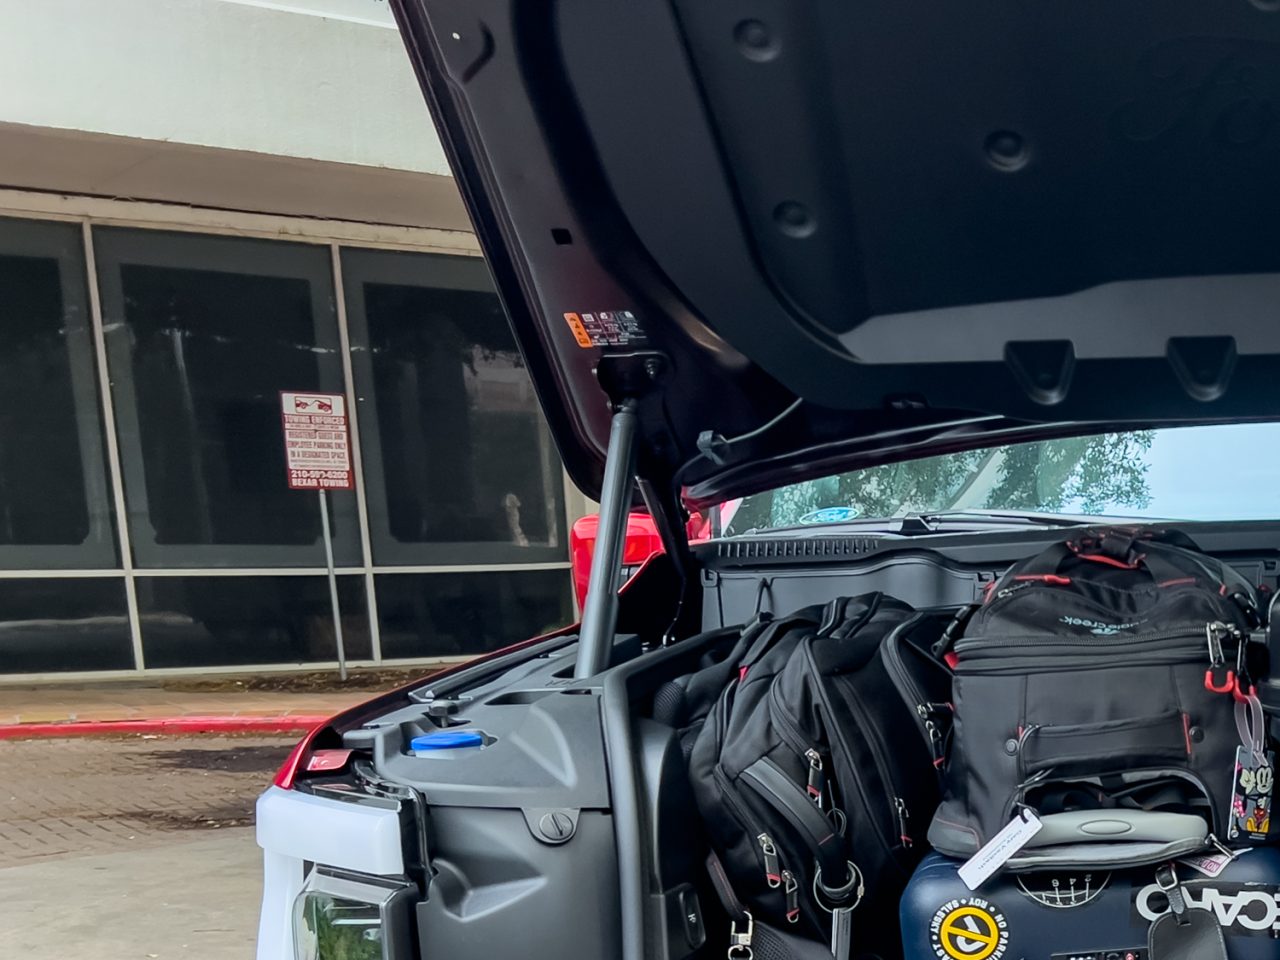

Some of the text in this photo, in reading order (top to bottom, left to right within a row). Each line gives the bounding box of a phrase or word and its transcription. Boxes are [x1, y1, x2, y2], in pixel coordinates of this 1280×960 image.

[285, 415, 345, 425] TOWING ENFORCED
[313, 441, 334, 449] PARKING
[319, 478, 349, 487] TOWING
[930, 897, 989, 933] ROY SALESKY
